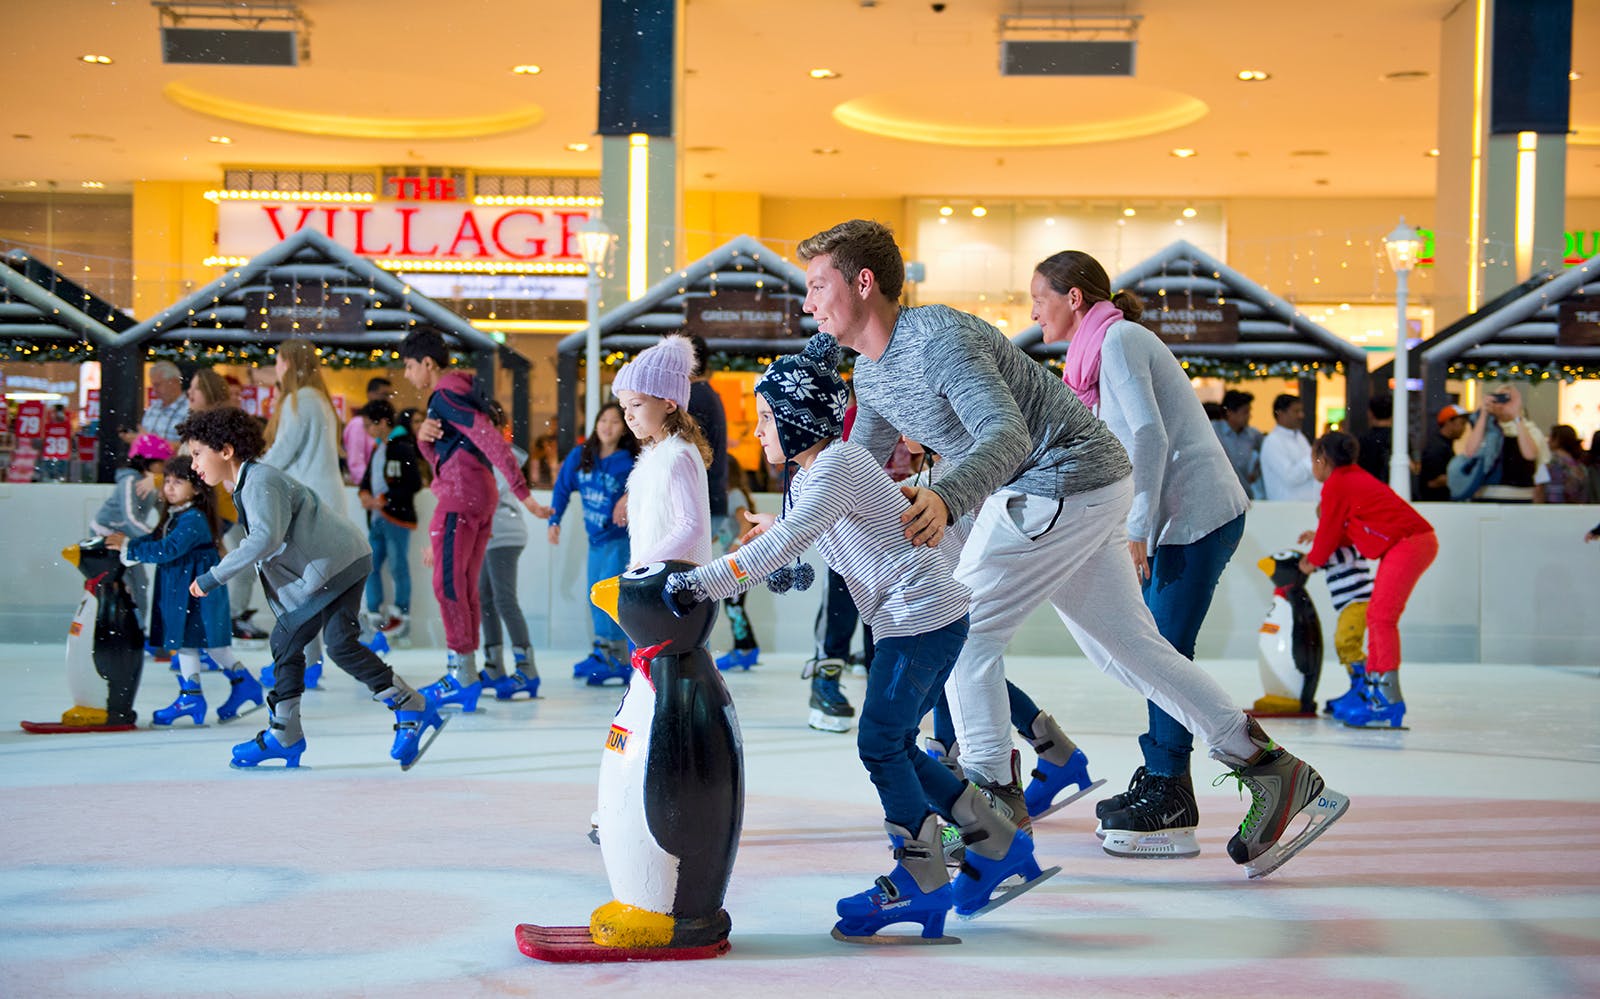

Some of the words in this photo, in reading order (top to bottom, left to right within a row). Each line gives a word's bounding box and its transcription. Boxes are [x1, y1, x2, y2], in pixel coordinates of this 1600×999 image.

[389, 176, 457, 201] THE
[262, 206, 590, 260] VILLAGE
[1160, 310, 1224, 322] INVENTING
[19, 415, 40, 435] 79
[44, 436, 70, 455] 39
